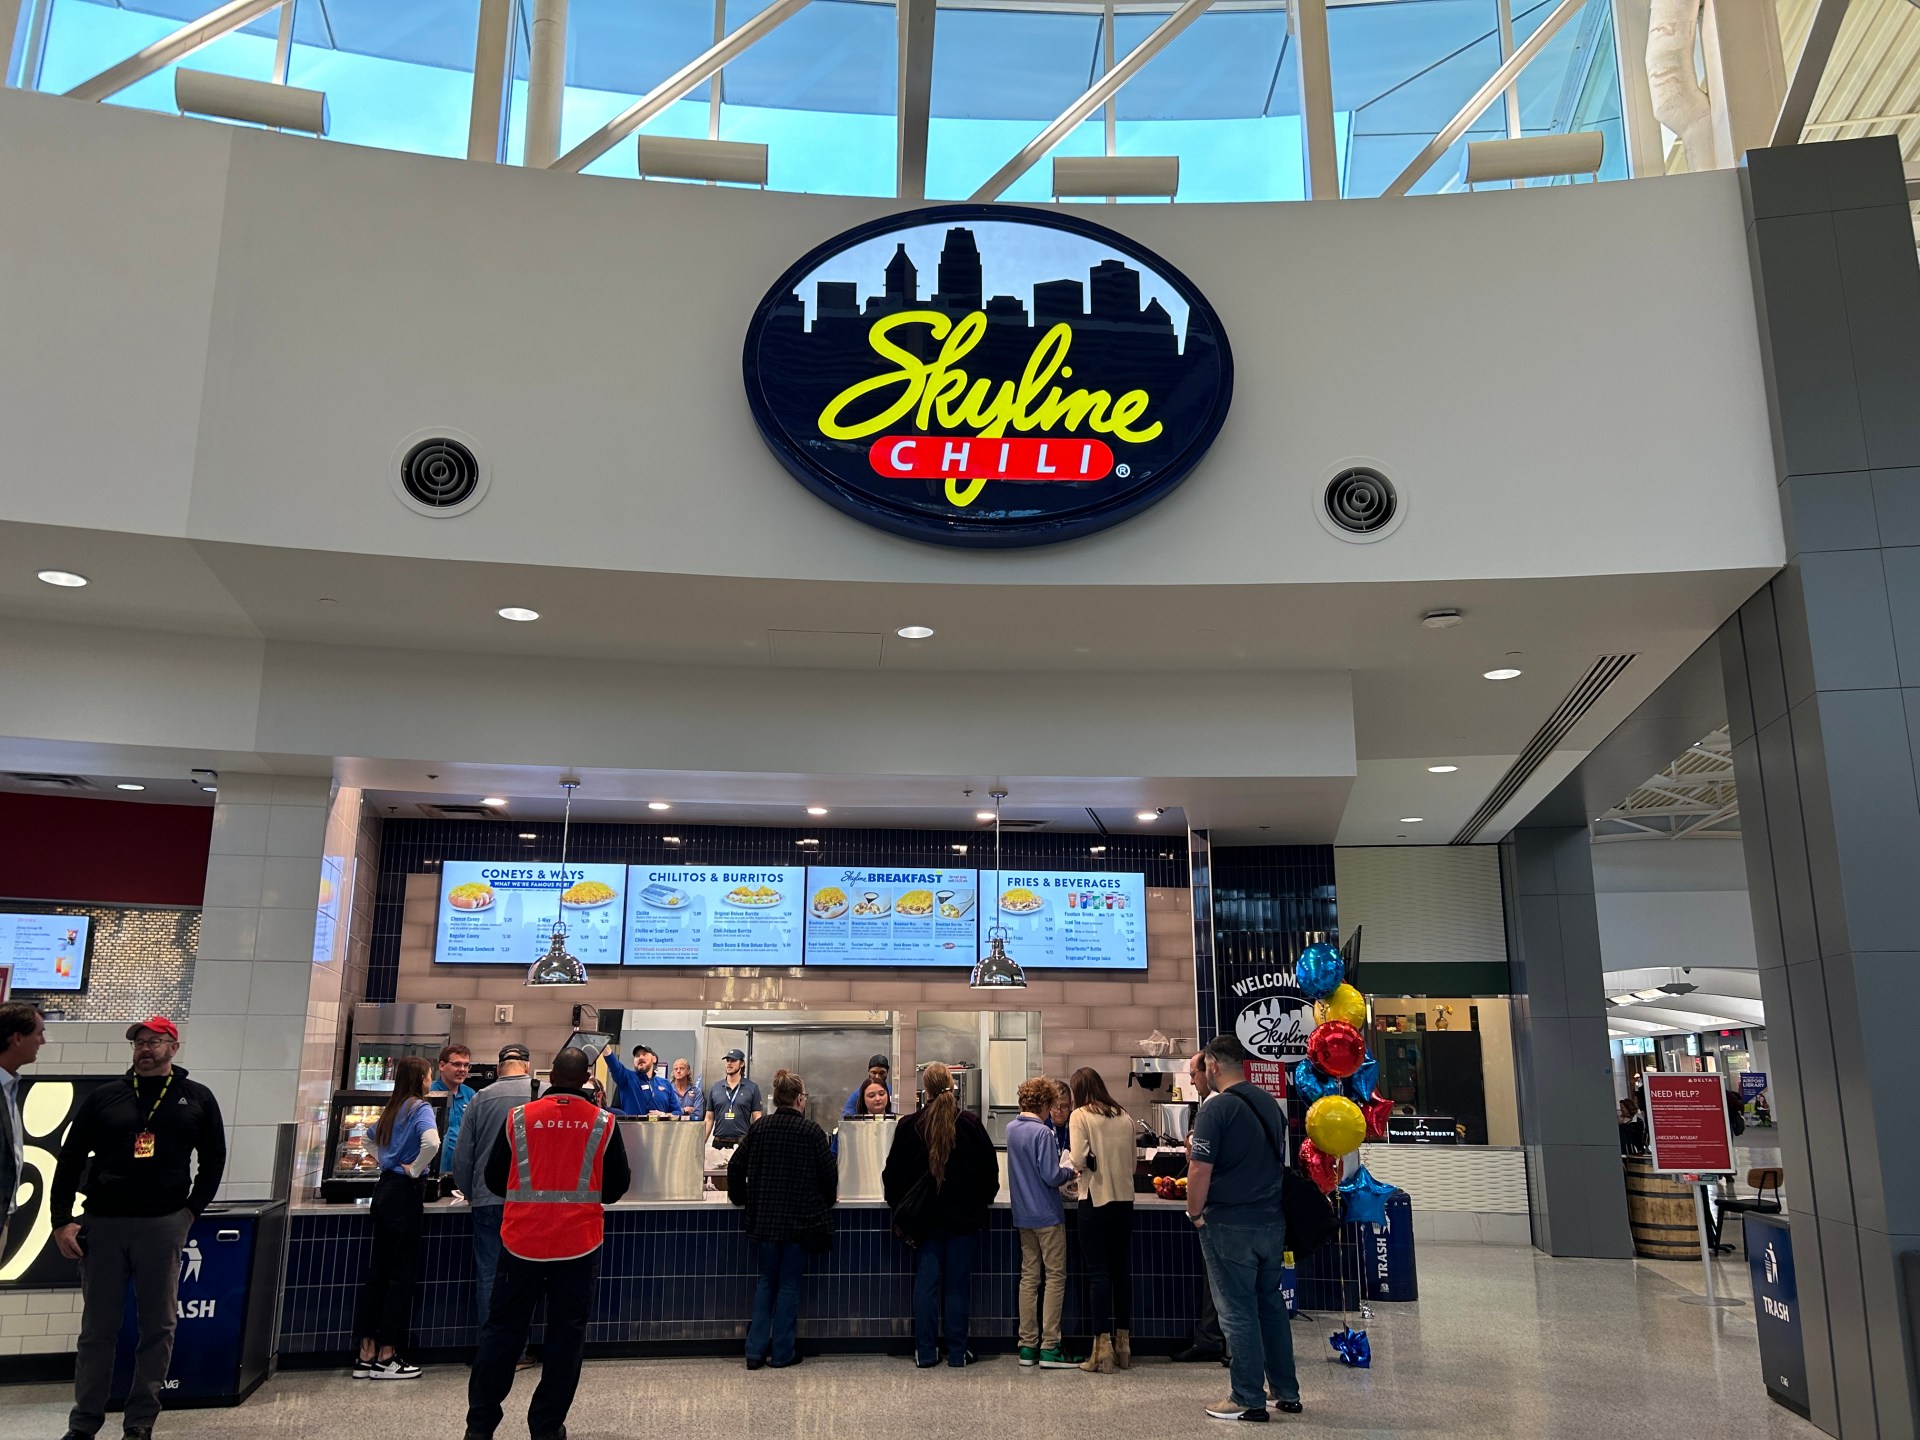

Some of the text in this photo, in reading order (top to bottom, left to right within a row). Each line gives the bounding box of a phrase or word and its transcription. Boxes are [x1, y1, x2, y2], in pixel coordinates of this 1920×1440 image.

[817, 310, 1163, 508] Skyline
[889, 440, 1092, 474] CHILI
[481, 868, 584, 880] CONEYS & WAYS
[648, 872, 784, 883] CHILITOS & BURRITOS
[840, 870, 943, 887] Skyline BREAKFAST
[1007, 877, 1121, 888] FRIES & BEVERAGES
[1231, 972, 1301, 997] WELCOM
[1249, 1017, 1309, 1060] Skylin
[1261, 1046, 1304, 1054] CHILI
[1250, 1062, 1279, 1073] VETERANS
[1250, 1073, 1263, 1083] EAT
[1263, 1074, 1280, 1084] FREE
[1650, 1090, 1700, 1098] NEED HELP?
[547, 1120, 589, 1129] DELTA
[1376, 1237, 1389, 1279] TRASH
[176, 1299, 217, 1319] ASH
[1762, 1295, 1790, 1323] TRASH
[161, 1379, 181, 1389] VG
